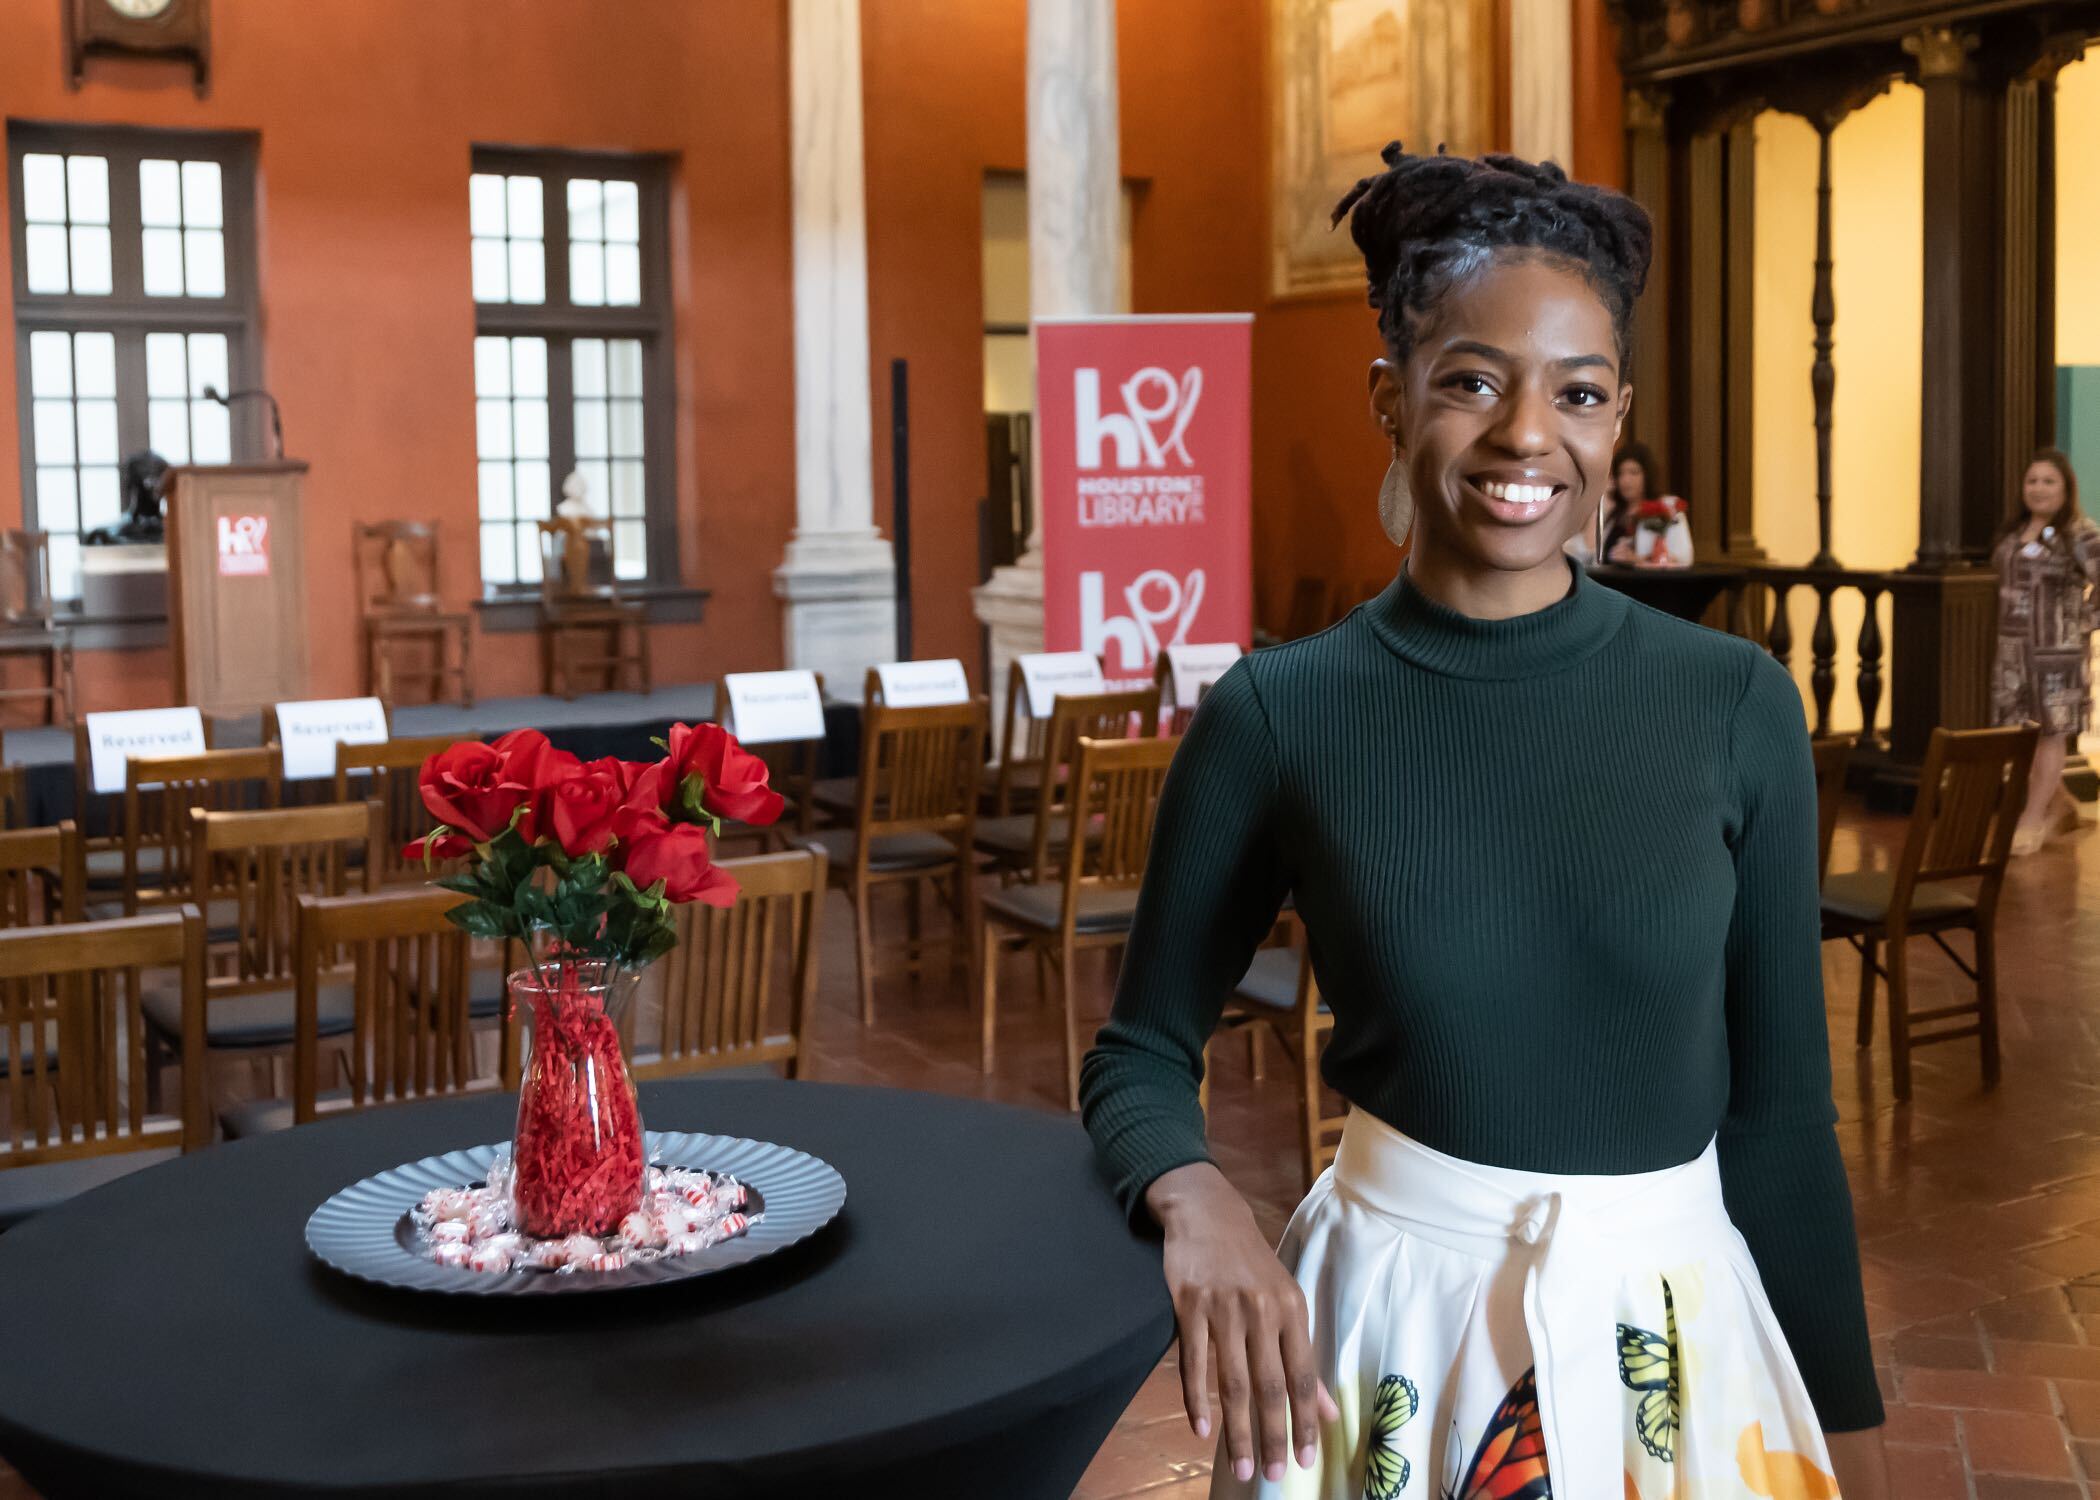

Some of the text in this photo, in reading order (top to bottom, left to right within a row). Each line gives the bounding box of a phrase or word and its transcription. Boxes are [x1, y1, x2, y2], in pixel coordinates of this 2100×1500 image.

[1077, 476, 1192, 494] HOUSTON
[1078, 495, 1191, 526] LIBRARY
[101, 729, 193, 748] Reserved
